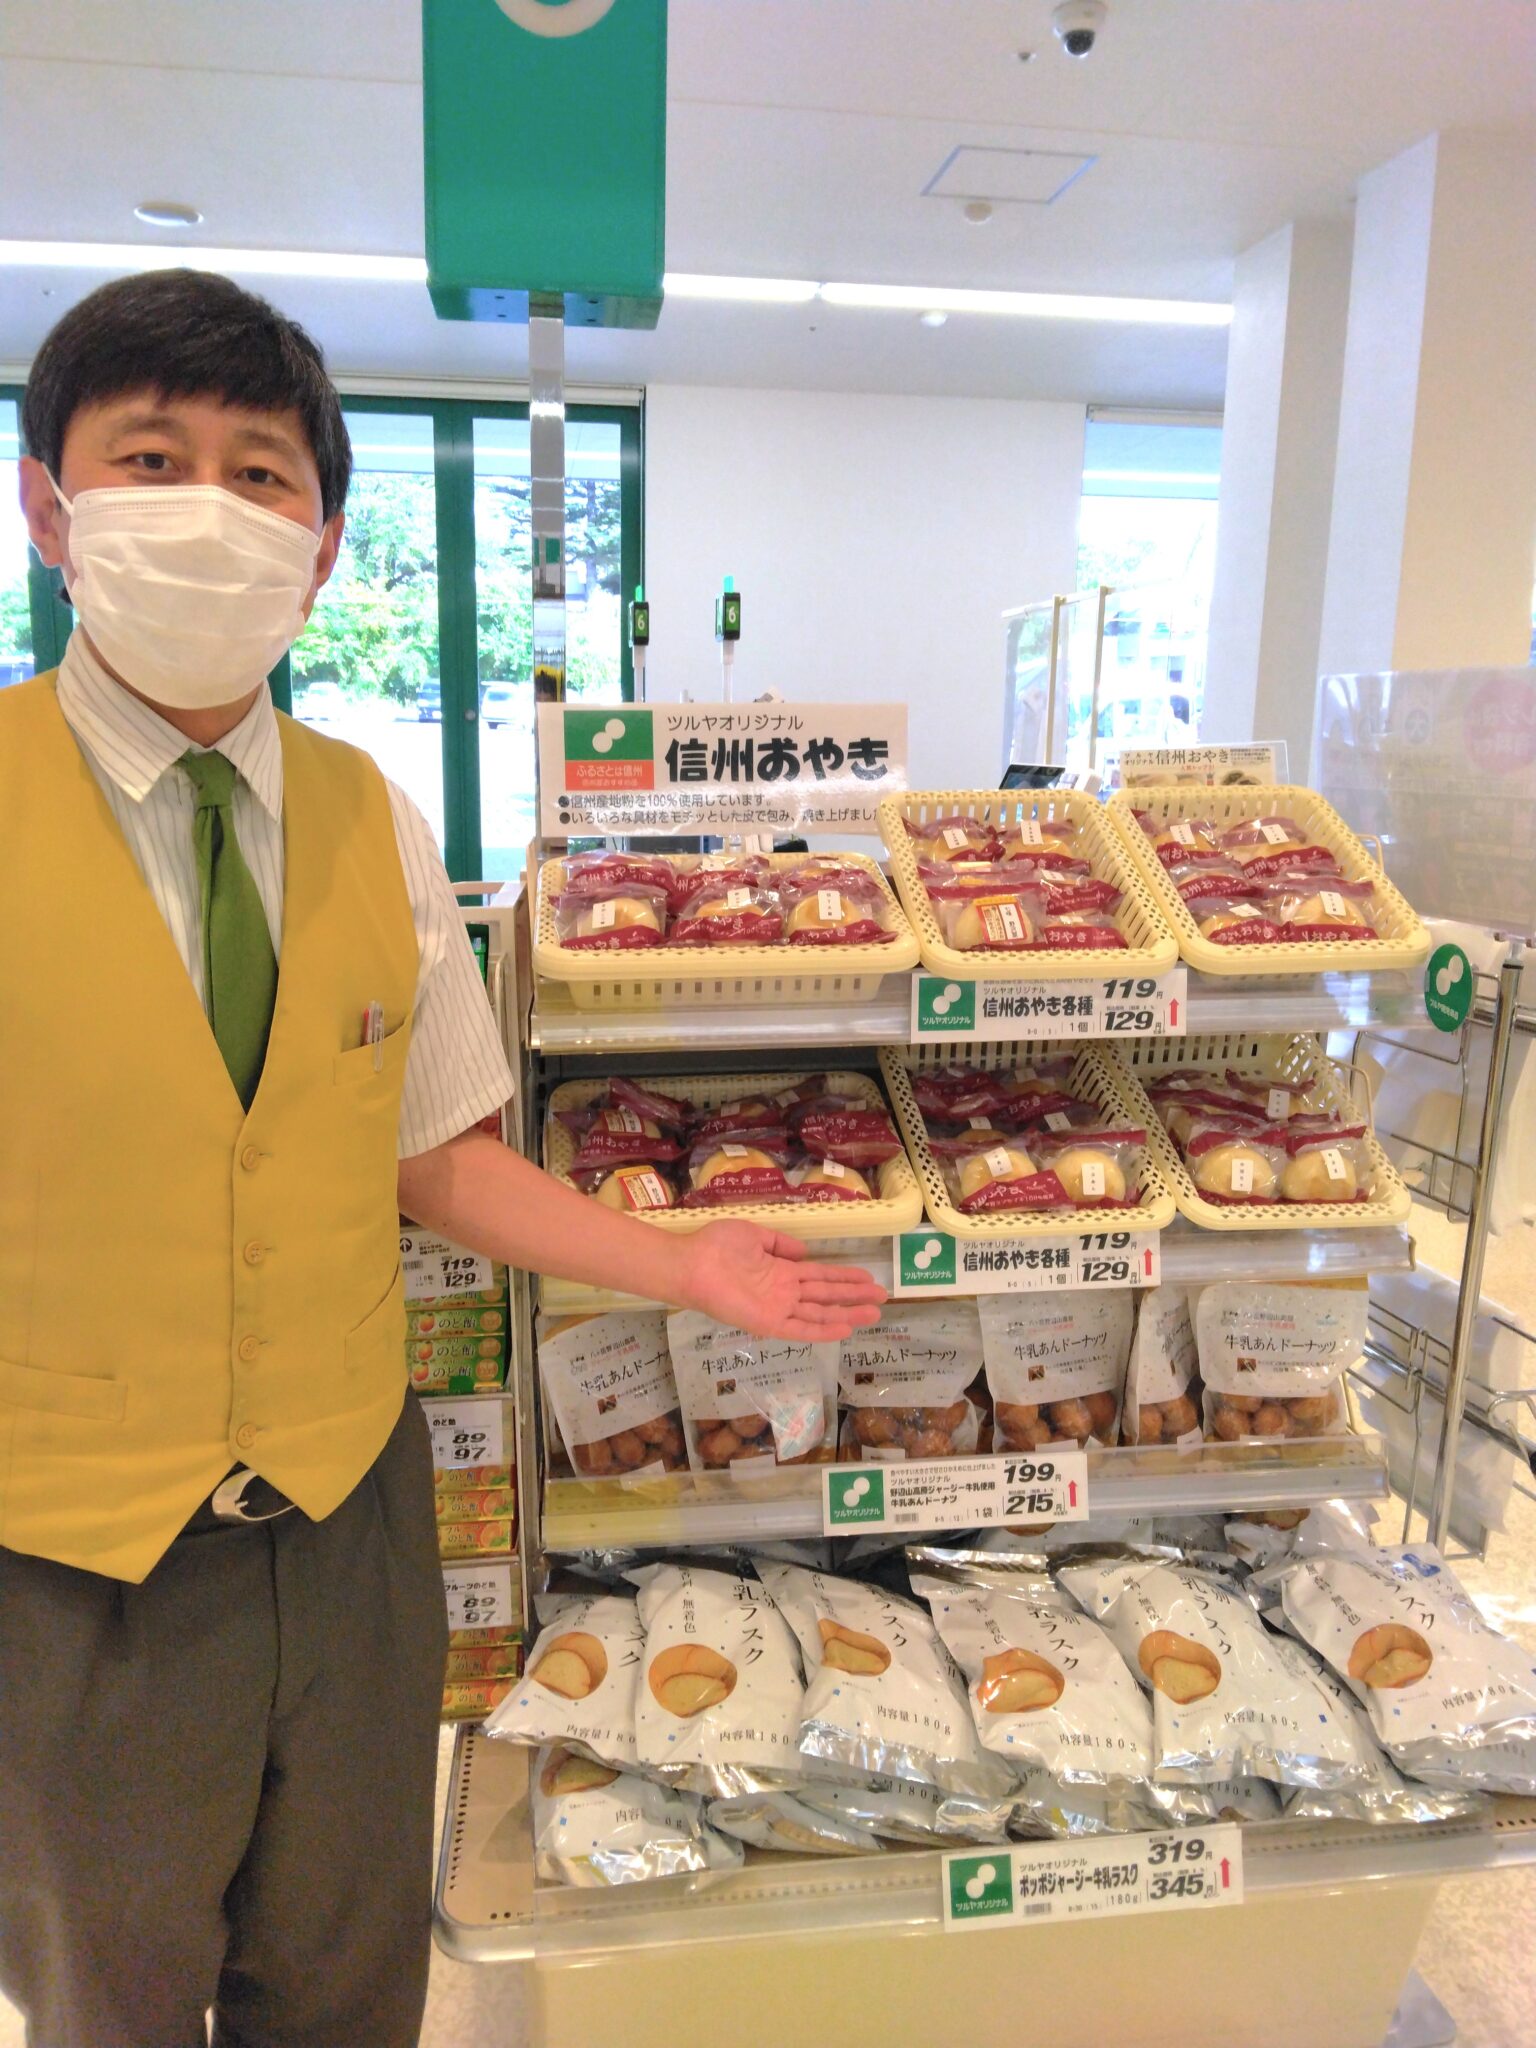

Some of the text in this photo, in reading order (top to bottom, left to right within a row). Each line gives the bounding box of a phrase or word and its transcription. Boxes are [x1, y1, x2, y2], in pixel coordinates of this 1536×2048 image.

[729, 606, 737, 624] 6
[637, 614, 645, 631] 6
[666, 713, 804, 732] ツルヤオリジナル
[664, 736, 889, 784] 信州おやき
[1155, 749, 1229, 766] 信州おやき
[576, 765, 643, 778] ふるさとは信州
[1049, 929, 1087, 943] おやき
[983, 985, 1047, 994] ツルヤオリジナル
[982, 994, 1094, 1018] 信州おやき各種
[922, 1016, 971, 1025] ツルヤオリジナル
[963, 1240, 1025, 1249] ツルヤオリジナル
[963, 1248, 1071, 1272] 信州おやき各種
[444, 1272, 477, 1288] 129
[904, 1270, 953, 1280] ツルヤオリジナル
[1014, 1331, 1108, 1361] 牛乳あんドーナッツ
[1224, 1334, 1337, 1353] 牛乳あんドーナッツ
[701, 1343, 813, 1375] 牛乳あんドーナッツ
[843, 1348, 957, 1368] 牛乳あんドーナッツ
[452, 1432, 487, 1444] 89
[453, 1447, 487, 1461] 97
[890, 1475, 951, 1486] ツルヤオリジナル
[890, 1494, 958, 1508] 牛乳あんドーナツ
[834, 1507, 881, 1519] ツルヤオリジナル
[463, 1596, 496, 1609] 89
[465, 1611, 496, 1624] 97
[1019, 1858, 1088, 1873] ツルヤオリジナル
[956, 1898, 1009, 1912] ツルヤオリジナル
